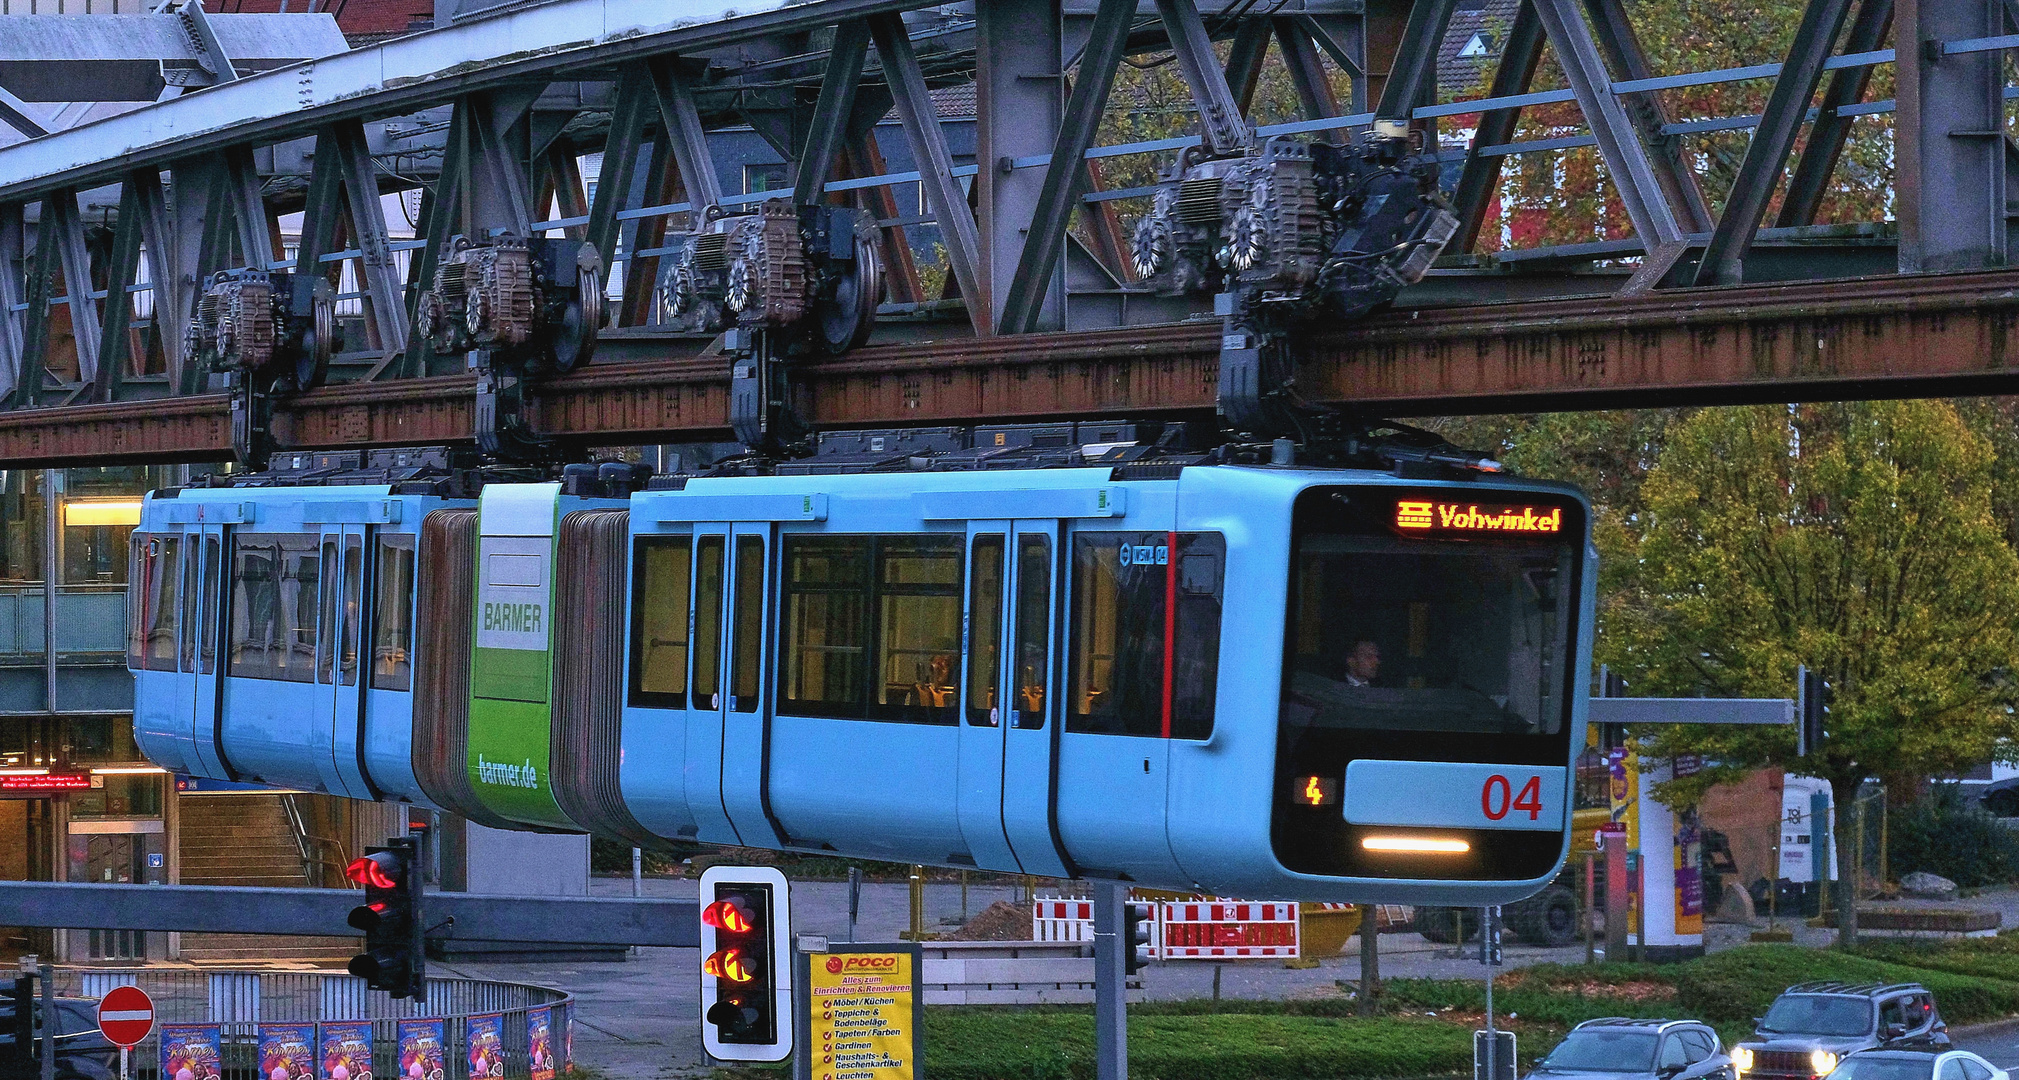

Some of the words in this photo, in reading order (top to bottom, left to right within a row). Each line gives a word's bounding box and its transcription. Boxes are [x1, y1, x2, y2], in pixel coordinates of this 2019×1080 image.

[1438, 504, 1561, 532] Vohwinkel
[1157, 548, 1167, 562] 04
[484, 602, 542, 633] BARMER
[479, 753, 538, 789] barmer.de
[1306, 776, 1323, 805] 4
[1481, 774, 1542, 821] 04
[845, 957, 896, 968] POCO
[842, 976, 863, 984] Alles
[813, 986, 856, 995] Einrichten
[866, 985, 911, 993] Renovieren
[834, 1009, 871, 1018] Teppiche
[834, 1018, 887, 1027] Bodenbeläge
[835, 1042, 872, 1050] Gardinen
[835, 1052, 879, 1061] Haushalts-
[882, 1052, 889, 1060] &
[835, 1060, 902, 1069] Geschenkartikel
[836, 1072, 873, 1080] Leuchten
